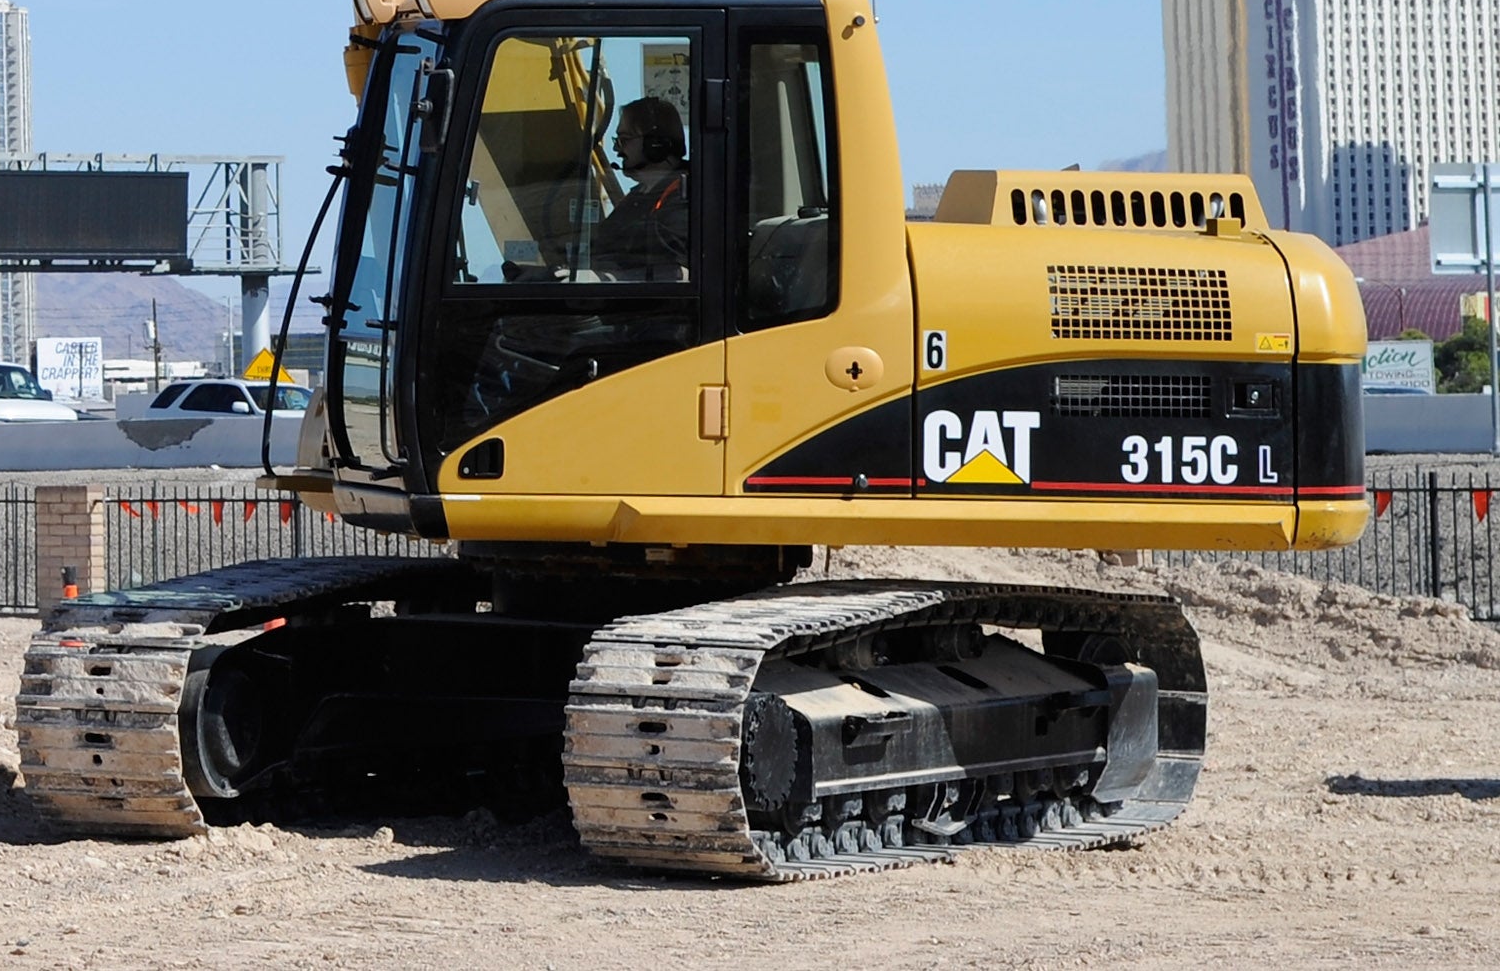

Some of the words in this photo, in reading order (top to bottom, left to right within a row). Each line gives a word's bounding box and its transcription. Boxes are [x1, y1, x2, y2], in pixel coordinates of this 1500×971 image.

[54, 341, 99, 355] CARER
[62, 354, 76, 367] IN
[77, 354, 99, 366] HE
[926, 331, 944, 369] 6
[1362, 346, 1425, 373] ction
[922, 409, 1042, 485] CAT
[1120, 434, 1240, 485] 315C
[1258, 445, 1279, 485] L
